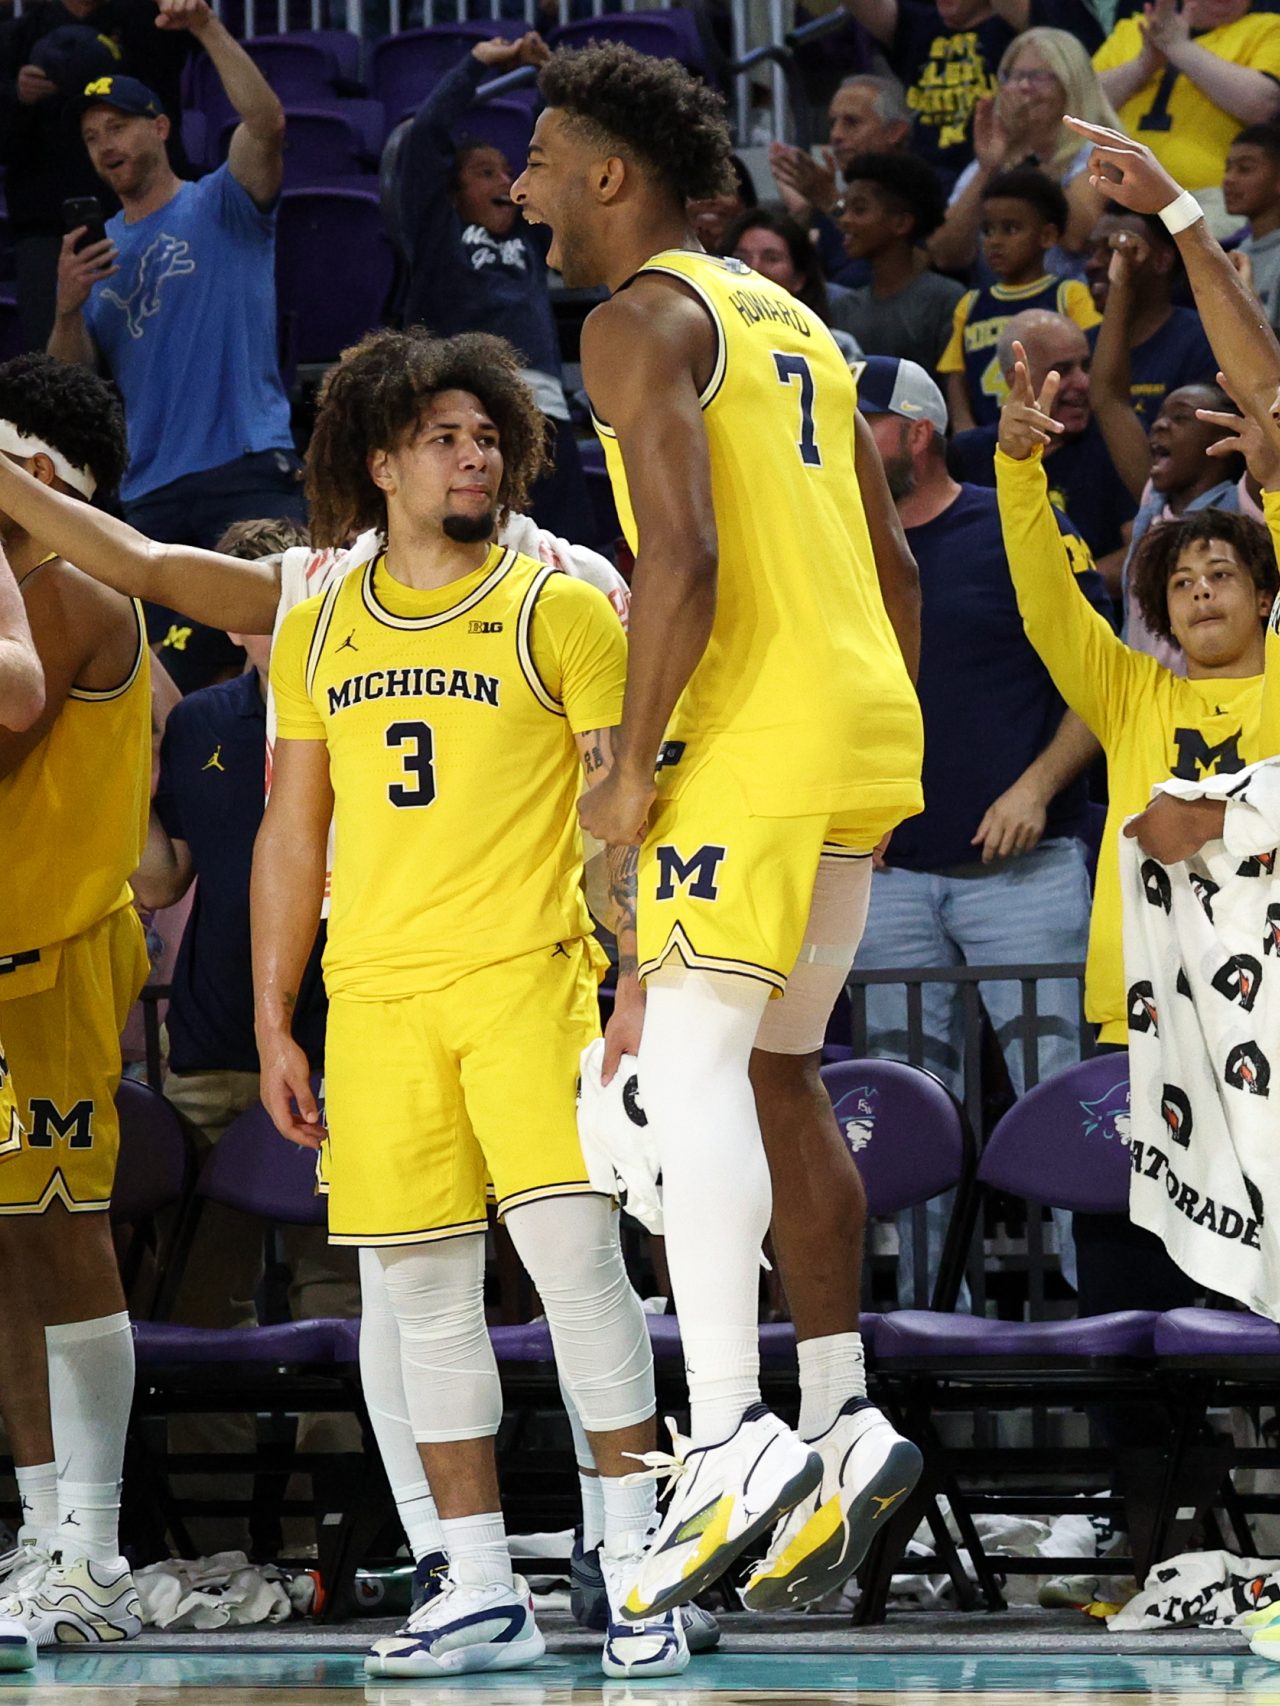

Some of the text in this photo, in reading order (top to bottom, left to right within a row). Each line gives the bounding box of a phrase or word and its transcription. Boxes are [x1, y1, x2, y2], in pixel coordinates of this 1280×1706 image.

[729, 289, 811, 337] HOWARD
[770, 350, 823, 467] 7
[326, 667, 500, 717] MICHIGAN
[385, 719, 437, 810] 3
[1170, 727, 1247, 783] M
[655, 843, 727, 902] M
[27, 1097, 94, 1149] M
[1131, 1139, 1261, 1251] ATORADE
